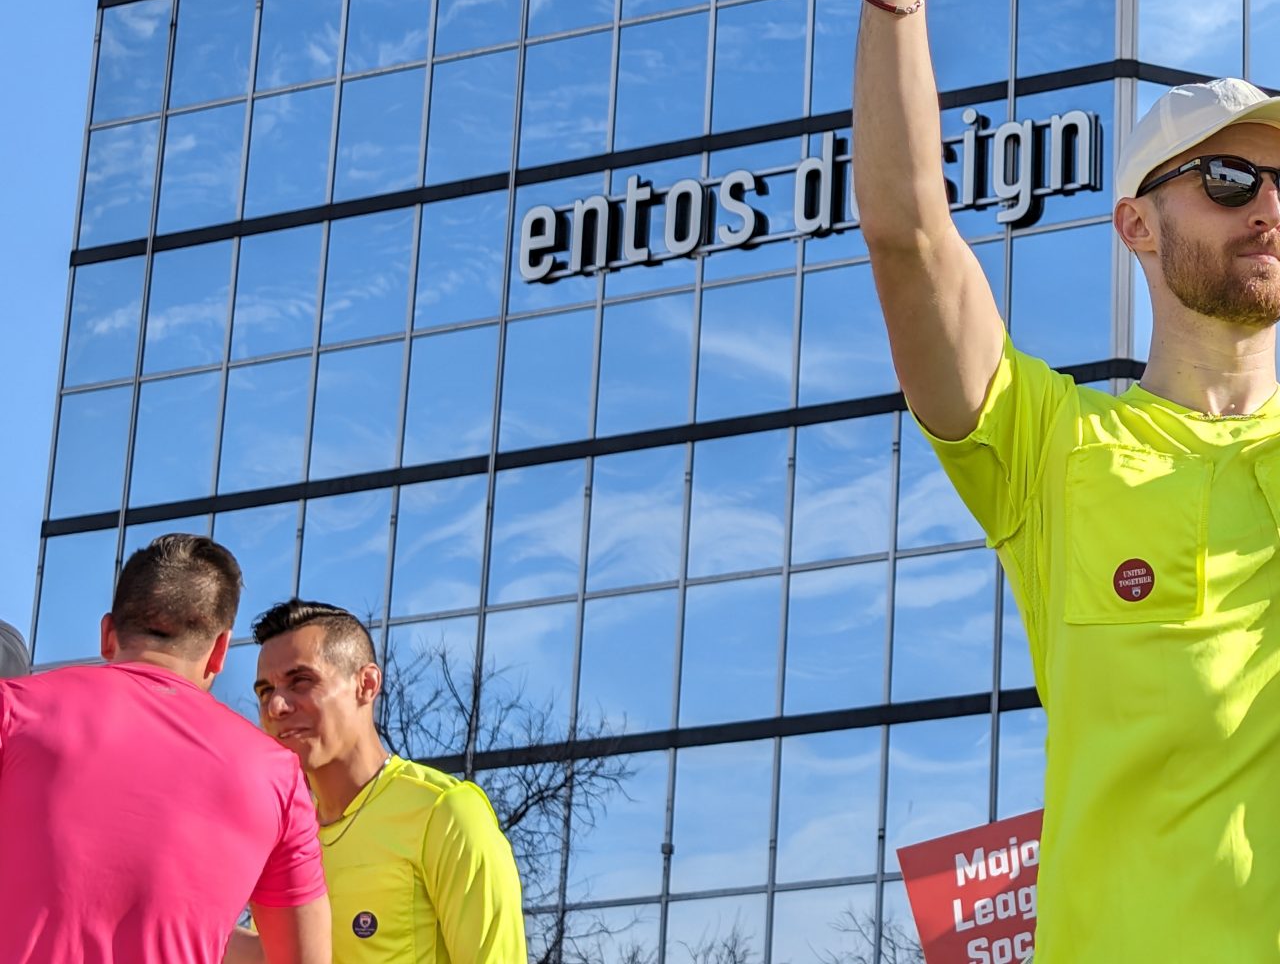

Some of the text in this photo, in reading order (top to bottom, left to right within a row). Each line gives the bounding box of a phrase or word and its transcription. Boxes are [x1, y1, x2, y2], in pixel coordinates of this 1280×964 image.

[519, 108, 1092, 282] entos dign
[1119, 576, 1152, 587] TOGETHER
[1123, 568, 1146, 578] UNITED
[955, 837, 1040, 886] Majo
[953, 885, 1037, 932] Leag
